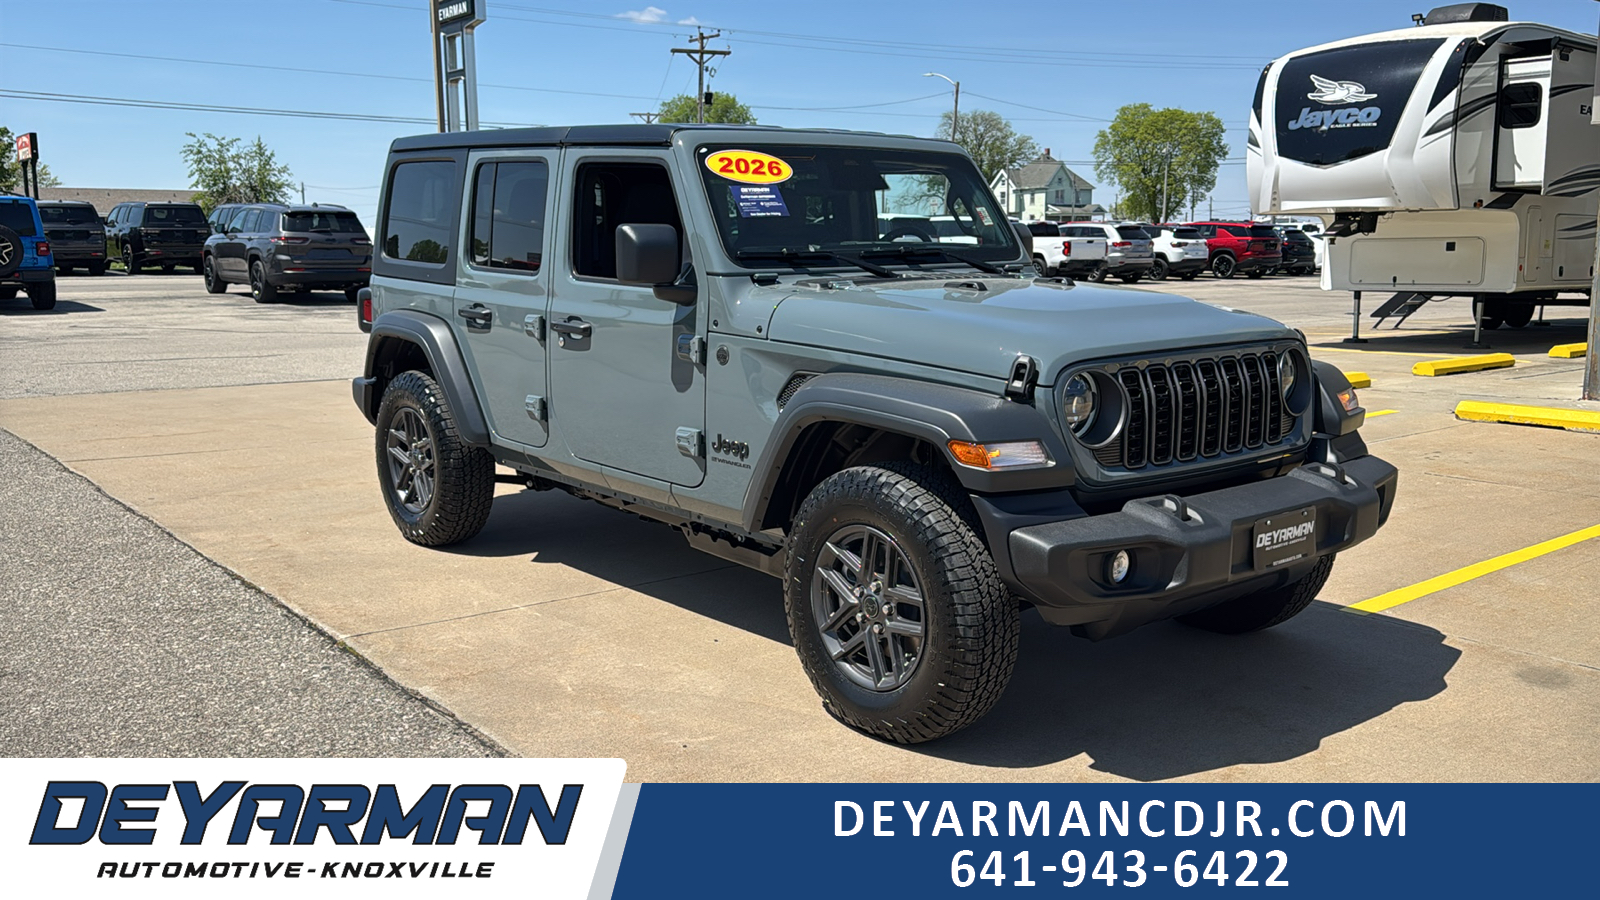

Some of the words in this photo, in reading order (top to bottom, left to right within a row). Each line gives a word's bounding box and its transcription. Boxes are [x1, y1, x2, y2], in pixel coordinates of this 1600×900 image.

[438, 1, 468, 21] EYARMAN
[1288, 106, 1381, 131] Jayco
[718, 156, 783, 177] 2026
[711, 433, 750, 462] Jeep
[717, 457, 752, 470] WRANGLER
[1256, 520, 1315, 549] DEYARMAN
